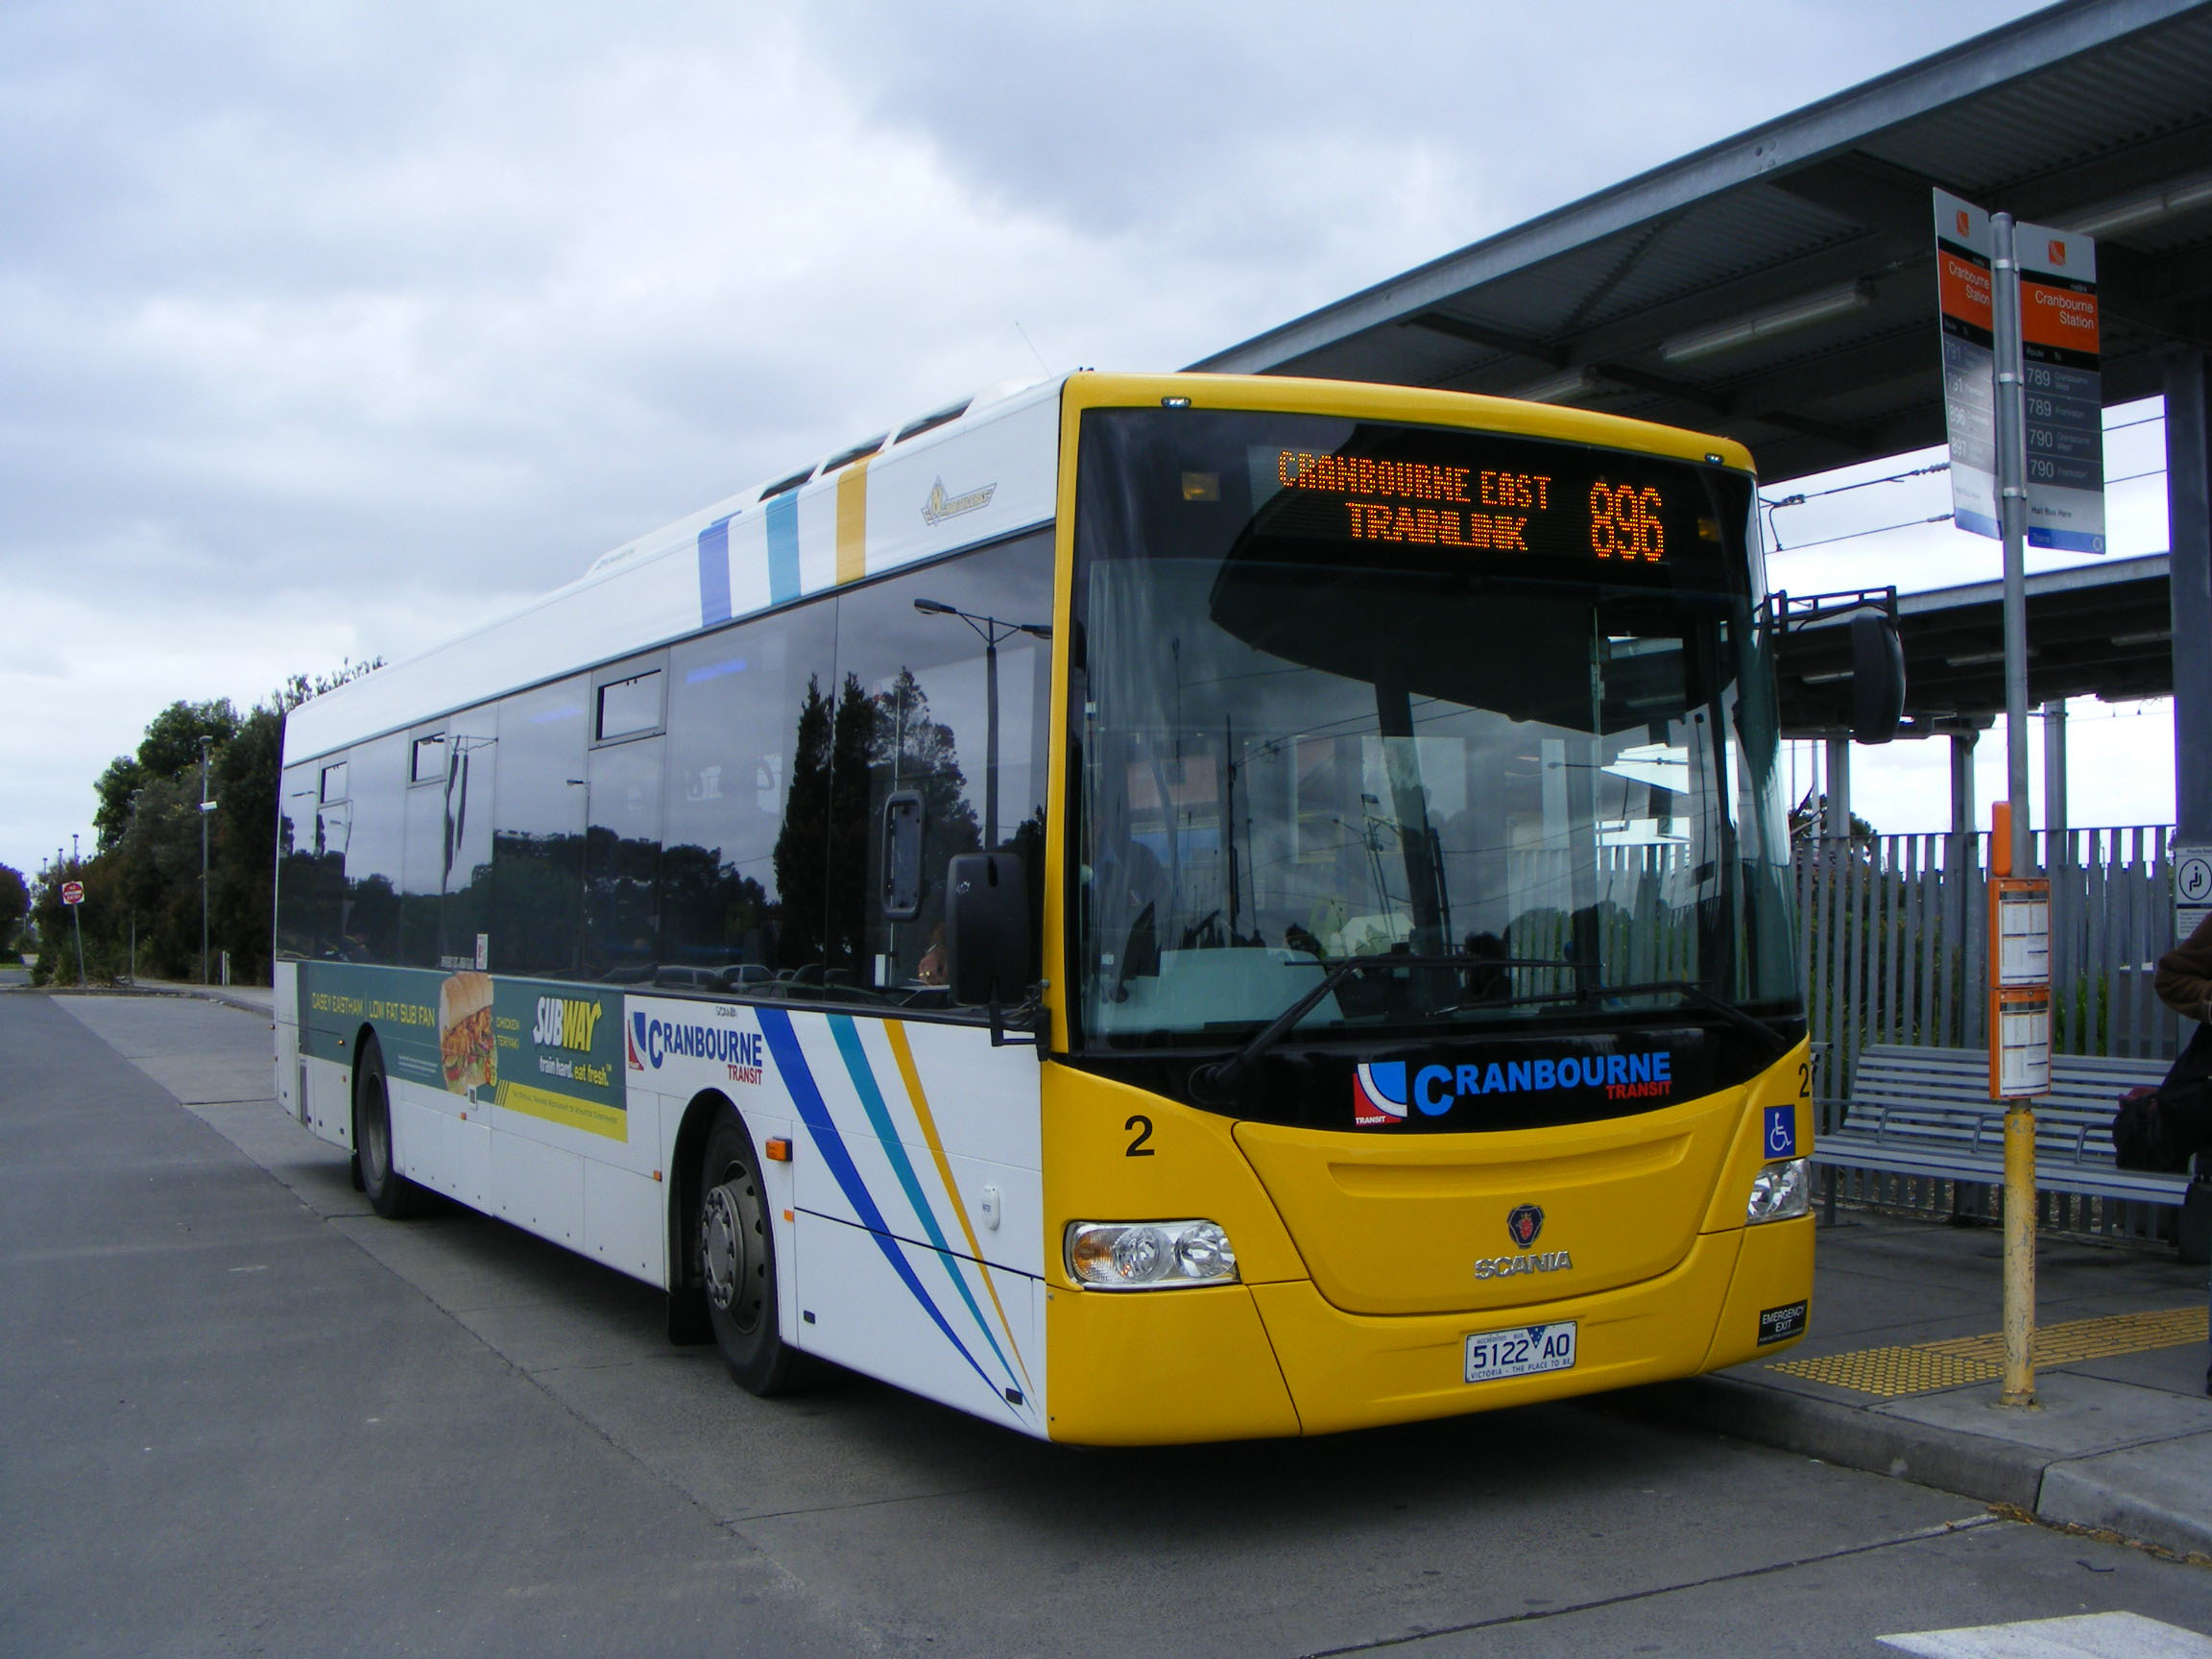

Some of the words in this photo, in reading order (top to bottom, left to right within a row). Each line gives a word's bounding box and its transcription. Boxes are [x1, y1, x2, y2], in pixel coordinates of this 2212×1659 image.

[1949, 261, 1990, 290] Cranbourne
[1965, 284, 1990, 305] Station
[2035, 290, 2094, 314] Cranbourne
[2059, 310, 2095, 329] Station
[2027, 368, 2051, 387] 789
[2028, 398, 2052, 417] 789
[2030, 429, 2053, 447] 790
[1279, 449, 1471, 503] CRANBOURNE
[1480, 470, 1551, 510] EAST
[2030, 460, 2054, 478] 790
[1345, 501, 1528, 551] TRAINLINK
[1589, 480, 1665, 562] 896
[369, 999, 384, 1019] LOW
[386, 1001, 398, 1021] FAT
[400, 1003, 417, 1024] SUB
[419, 1005, 435, 1027] FAN
[533, 997, 602, 1052] SUBWAY
[648, 1019, 762, 1070] CRANBOURNE
[540, 1056, 555, 1074] train
[574, 1064, 586, 1082] eat
[728, 1064, 763, 1085] TRANSIT
[1798, 1062, 1810, 1098] 2
[1414, 1051, 1671, 1117] CRANBOURNE
[1605, 1080, 1672, 1100] TRANSIT
[1355, 1116, 1386, 1124] TRANSIT
[1124, 1115, 1155, 1157] 2
[1475, 1250, 1574, 1280] SCANIA
[1762, 1305, 1806, 1325] EMERGENCY
[1775, 1319, 1792, 1333] EXIT
[1474, 1339, 1529, 1369] 5122
[1470, 1368, 1503, 1380] VICTORIA
[1527, 1361, 1548, 1371] PLACE
